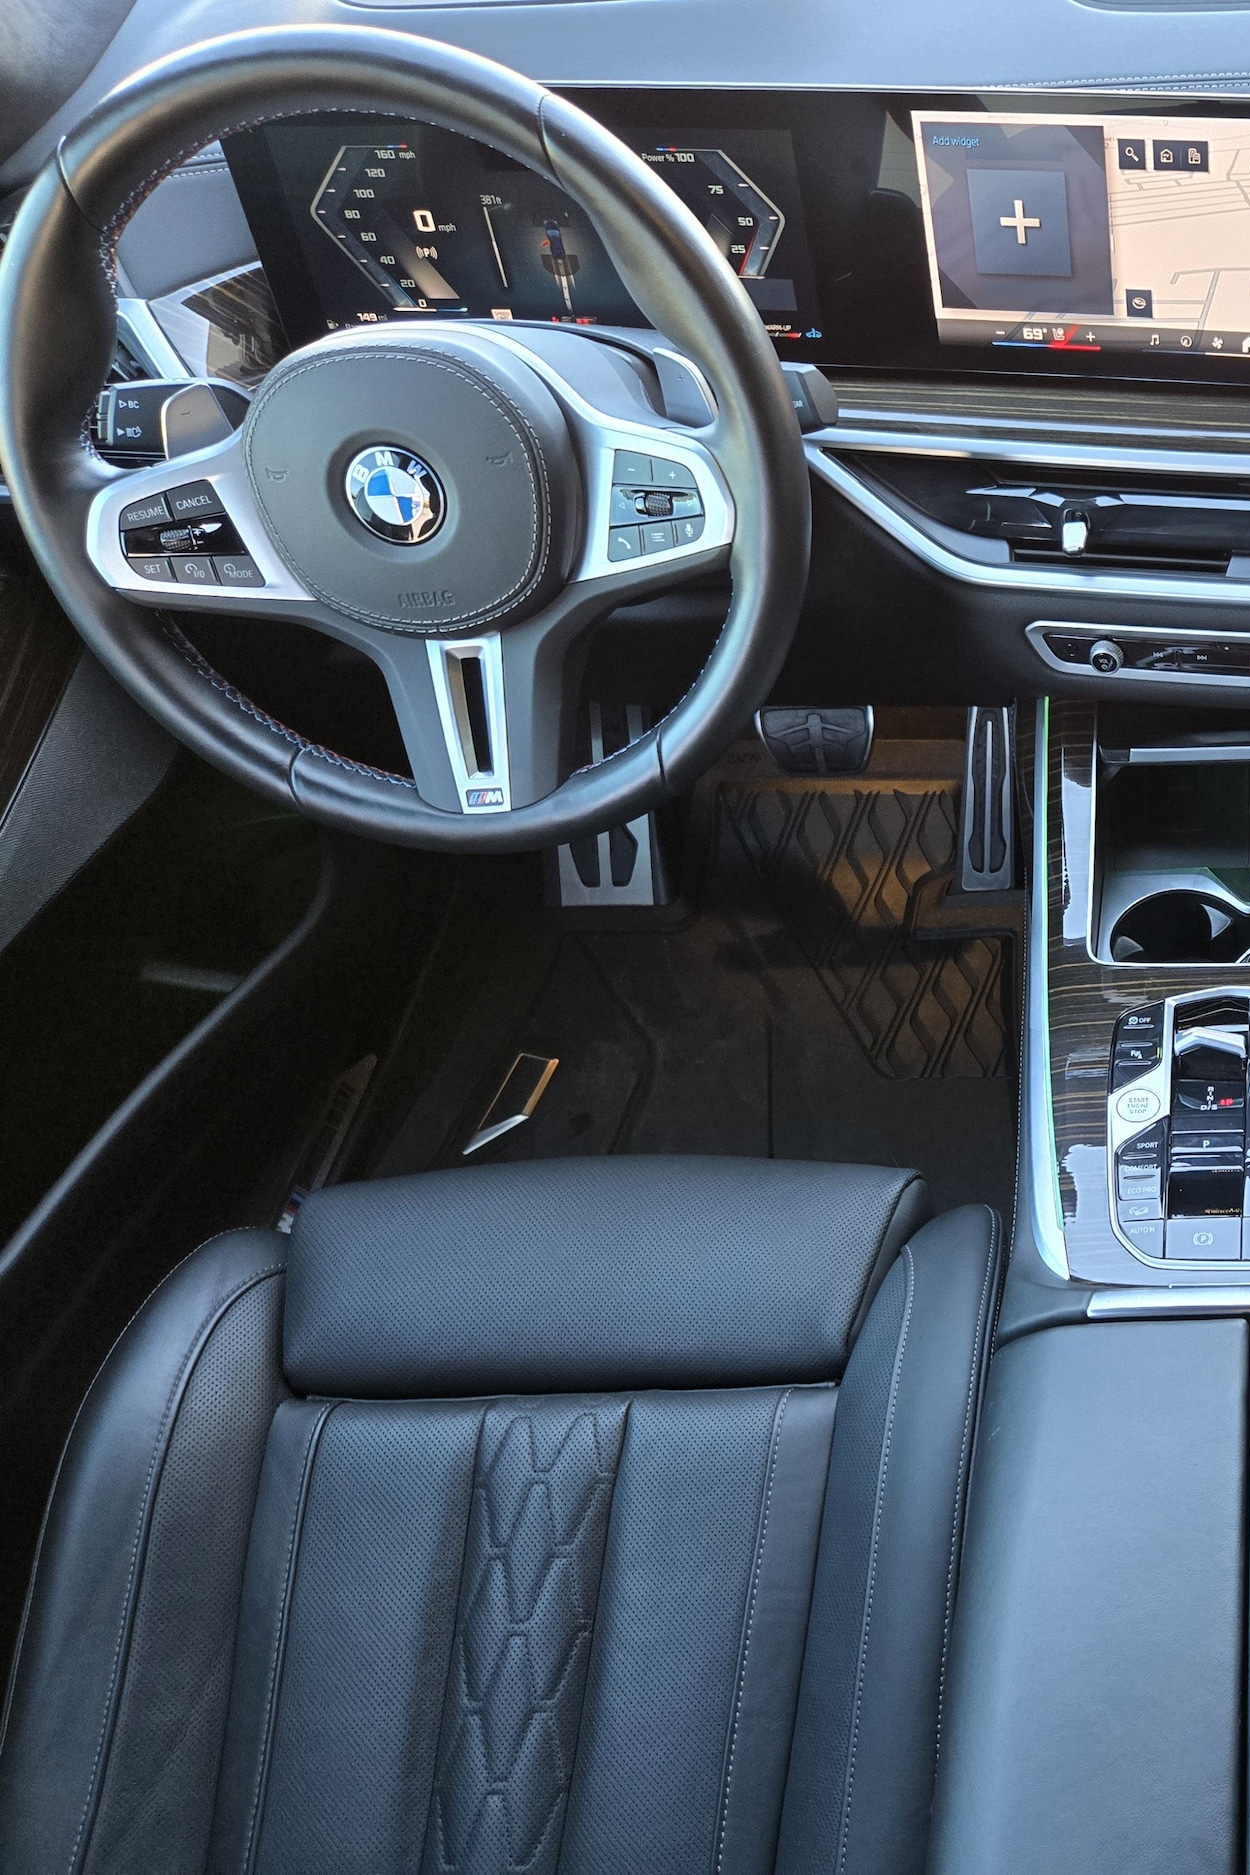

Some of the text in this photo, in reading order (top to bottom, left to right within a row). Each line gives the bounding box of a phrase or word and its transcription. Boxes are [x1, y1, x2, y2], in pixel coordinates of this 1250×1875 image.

[932, 136, 980, 149] Add widget
[374, 150, 416, 160] 160 mph
[641, 153, 665, 162] Power
[675, 153, 695, 163] 100
[365, 168, 386, 178] 120
[353, 189, 375, 198] 100
[708, 185, 724, 194] 75
[344, 210, 361, 219] 80
[412, 209, 457, 233] 0 mph
[738, 217, 754, 226] 50
[361, 232, 377, 242] 60
[731, 245, 746, 254] 25
[380, 256, 396, 265] 40
[400, 280, 416, 288] 20
[418, 299, 428, 308] 0
[356, 312, 378, 322] 149
[128, 401, 140, 409] BC
[352, 450, 428, 483] BMW
[176, 495, 212, 511] CANCEL
[127, 505, 165, 522] RESUME
[144, 564, 161, 574] SET
[229, 570, 254, 578] MODE
[398, 590, 456, 609] AIRBAG
[1202, 1140, 1211, 1149] P
[1124, 1164, 1158, 1172] COMFORT
